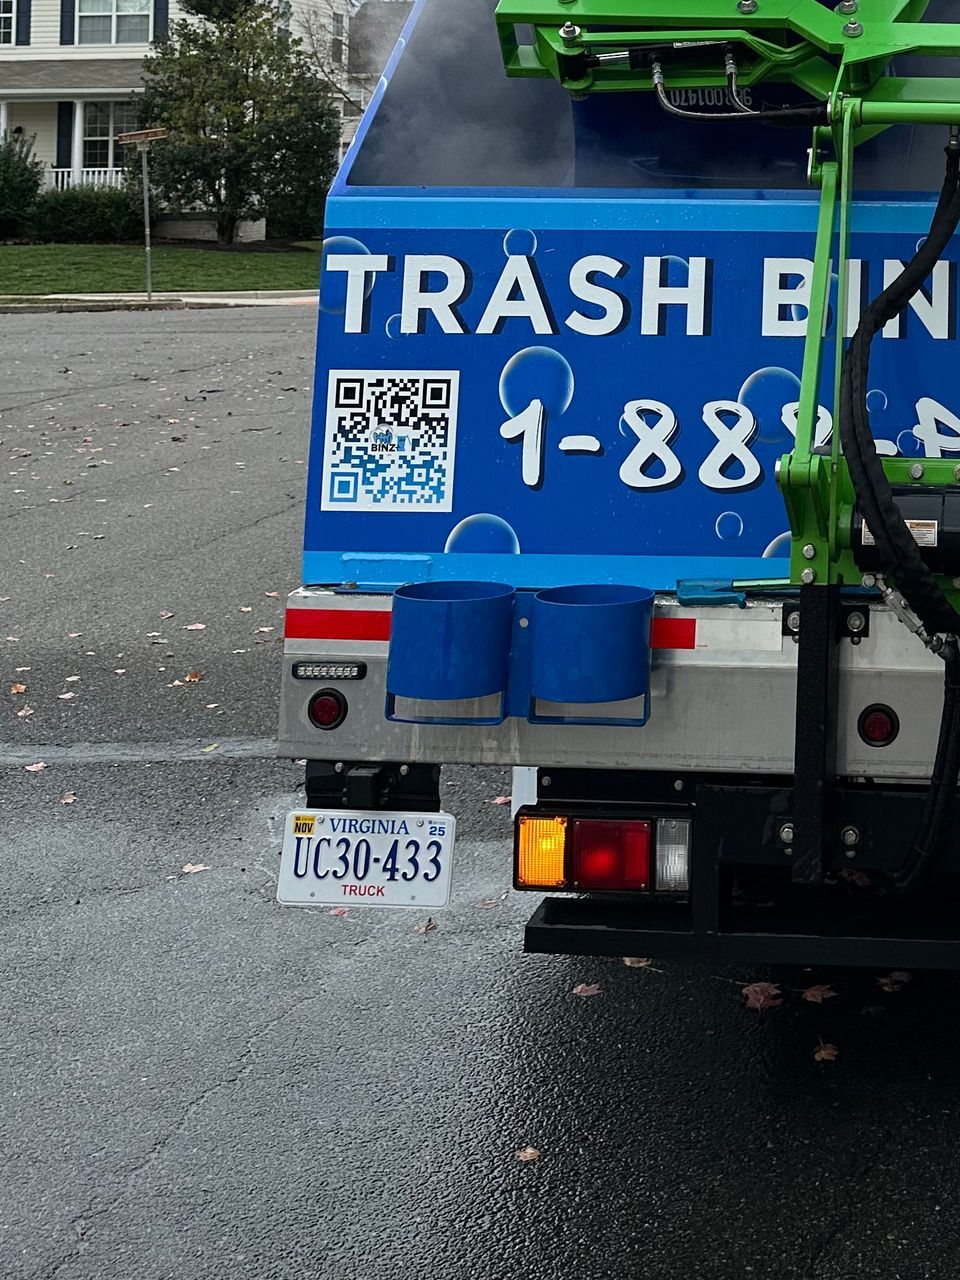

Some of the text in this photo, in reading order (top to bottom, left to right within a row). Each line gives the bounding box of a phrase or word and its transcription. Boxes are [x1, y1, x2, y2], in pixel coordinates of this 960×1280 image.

[326, 254, 708, 336] TRASH
[761, 257, 950, 340] BIN
[371, 444, 396, 452] BINZ
[294, 822, 313, 833] NOV
[329, 818, 410, 835] VIRGINIA
[429, 826, 446, 836] 25
[293, 836, 442, 882] UC30-433
[341, 884, 385, 897] TRUCK
